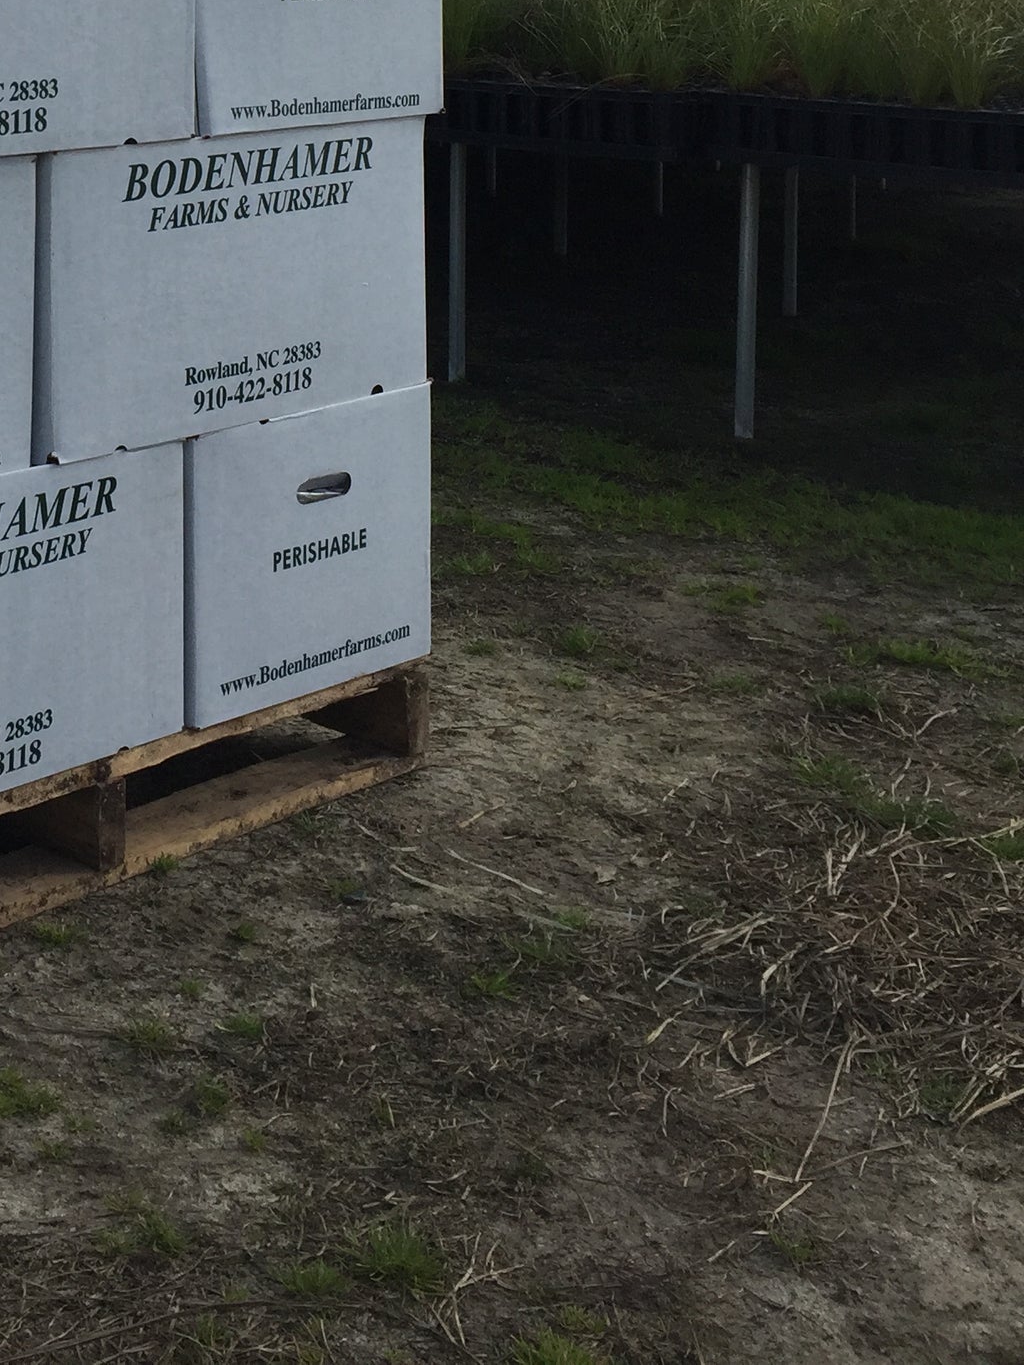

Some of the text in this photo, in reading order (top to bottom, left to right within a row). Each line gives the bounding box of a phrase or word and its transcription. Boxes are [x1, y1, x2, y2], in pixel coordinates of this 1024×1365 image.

[9, 78, 58, 101] 28383
[231, 93, 419, 119] www.Bodenhamerfarms.com
[122, 137, 373, 202] BODENHAMER
[147, 181, 353, 232] FARMS & NURSERY
[185, 341, 321, 386] Rowland, NC 28383
[194, 367, 312, 415] 910-422-8118
[273, 528, 366, 572] PERISHABLE
[220, 625, 410, 696] www.Bodenhamerfarms.com
[5, 709, 53, 747] 28383
